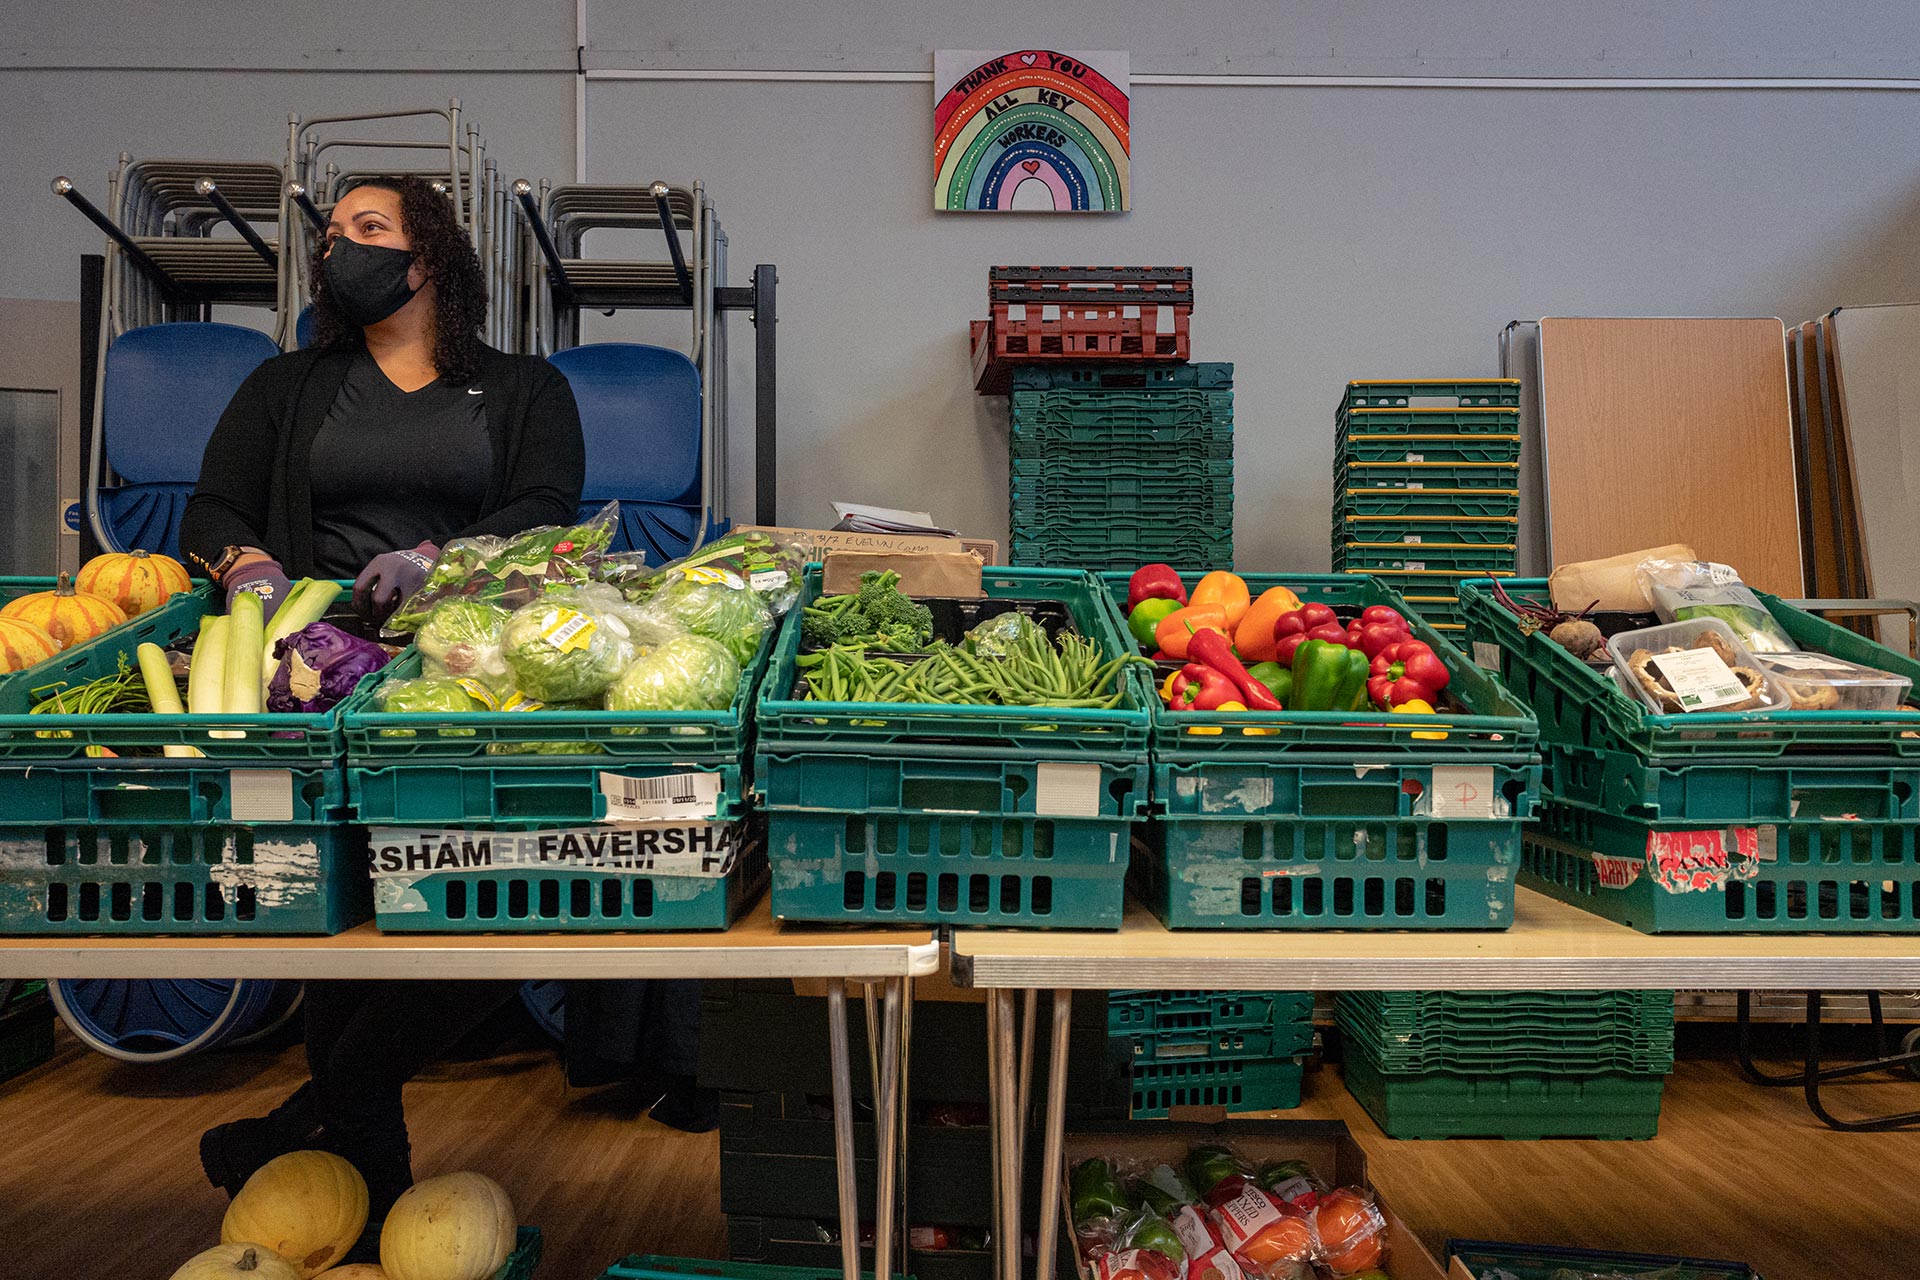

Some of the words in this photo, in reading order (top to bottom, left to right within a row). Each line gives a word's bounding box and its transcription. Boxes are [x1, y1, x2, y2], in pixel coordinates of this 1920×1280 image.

[956, 59, 1009, 96] THANK
[1047, 53, 1087, 79] YOU
[984, 94, 1020, 121] ALL
[1037, 88, 1075, 112] KEY
[997, 123, 1067, 149] WORKERS
[1246, 1188, 1267, 1210] TESCO
